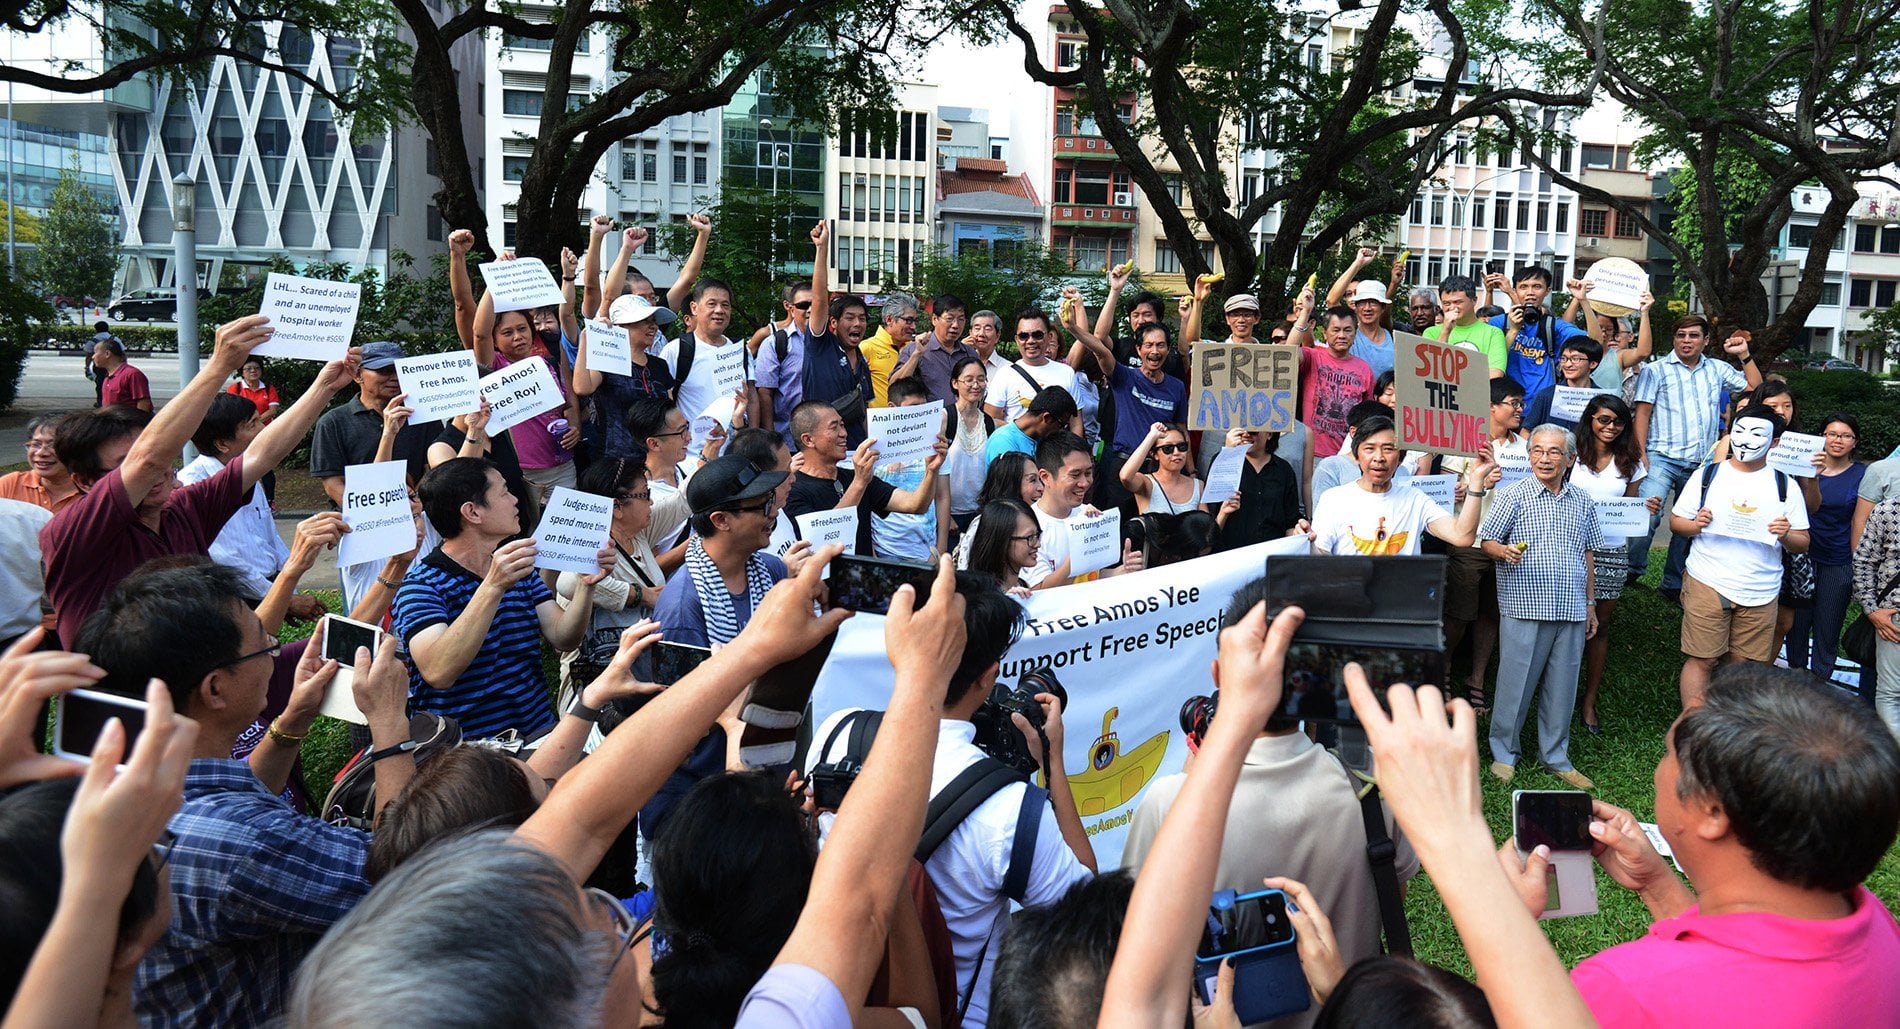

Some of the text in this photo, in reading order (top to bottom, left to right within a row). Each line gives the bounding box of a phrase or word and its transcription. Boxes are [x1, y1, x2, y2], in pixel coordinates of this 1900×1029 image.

[1595, 277, 1624, 287] persecute
[1598, 268, 1641, 282] Only criminals
[273, 282, 297, 293] LHL...
[300, 285, 328, 296] Scared
[343, 290, 357, 299] child
[275, 300, 293, 308] and
[308, 304, 351, 314] unemployed
[280, 314, 316, 326] hospital
[589, 324, 614, 336] Rudeness
[401, 358, 473, 374] Remove the gag.
[1202, 347, 1292, 390] FREE
[1415, 343, 1468, 385] STOP
[420, 374, 468, 389] Free Amos.
[480, 363, 538, 396] ree Amos!
[723, 376, 733, 384] not
[1327, 372, 1352, 385] ROCK
[514, 381, 541, 400] Roy!
[1425, 380, 1459, 411] THE
[430, 400, 472, 413] #FreeAmosYee
[500, 400, 542, 422] #FreeAmosYee
[1196, 389, 1291, 430] AMOS
[872, 414, 891, 422] Anal
[893, 409, 933, 420] intercourse
[902, 422, 927, 433] deviant
[1403, 406, 1486, 453] BULLYING
[887, 435, 924, 448] behaviour.
[895, 445, 932, 456] #FreeAmosYee
[348, 482, 407, 509] Free speech!
[563, 498, 608, 514] Judges should
[356, 521, 375, 532] #SG50
[550, 515, 607, 532] spend more time
[811, 514, 852, 527] #FreeAmosYee
[1070, 515, 1118, 531] Torturing children
[544, 534, 600, 549] on the internet.
[824, 530, 840, 541] #SG50
[1090, 534, 1098, 542] not
[538, 550, 596, 565] SG50 #FreeAmosYee
[1026, 586, 1200, 637] Free Amos Yee
[1002, 608, 1226, 680] upport Free Speech
[239, 720, 264, 740] tex
[1085, 809, 1134, 837] eeAmosY
